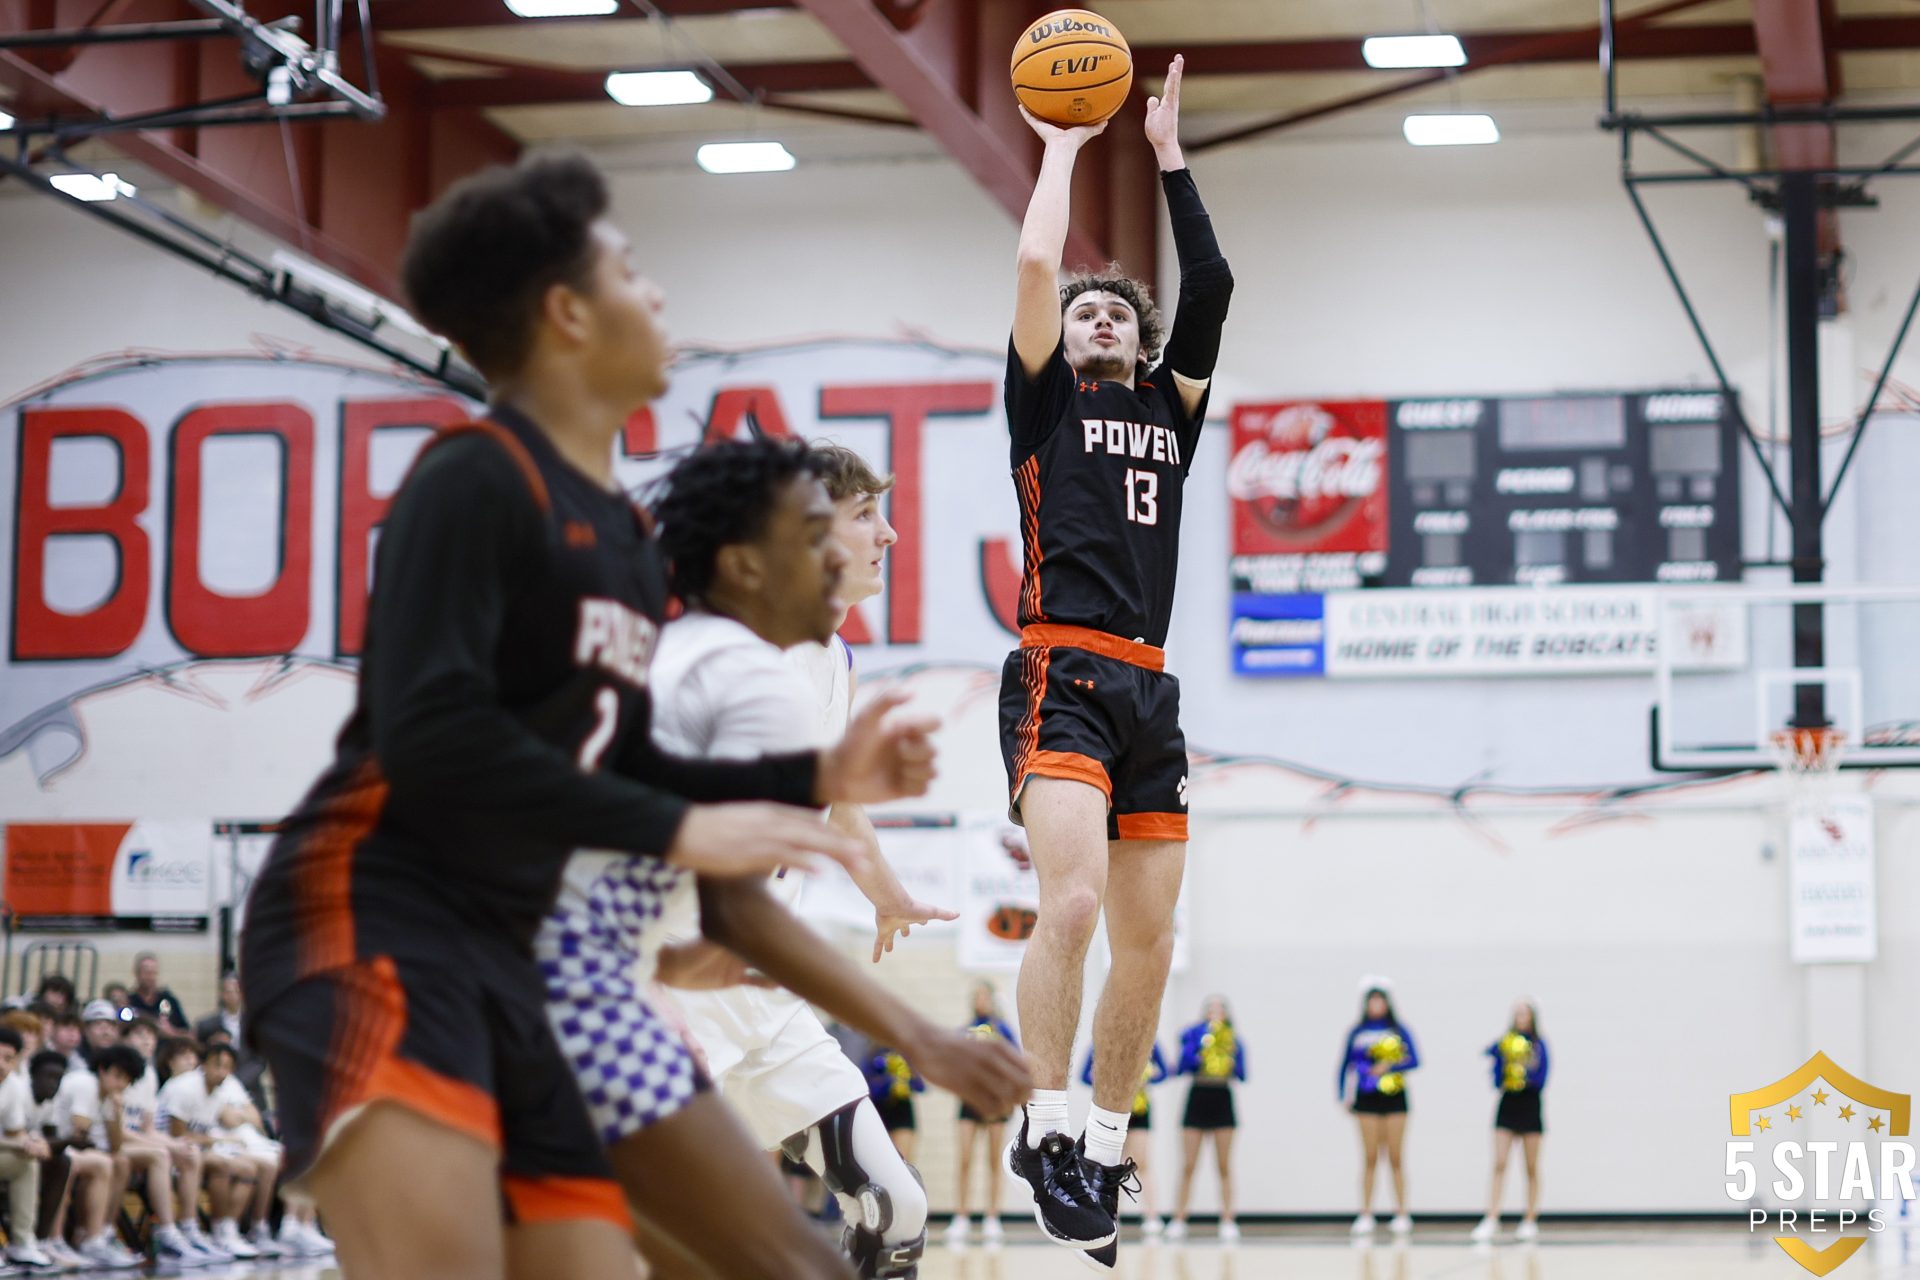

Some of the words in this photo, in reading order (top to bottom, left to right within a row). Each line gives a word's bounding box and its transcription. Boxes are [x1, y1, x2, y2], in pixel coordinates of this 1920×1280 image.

[1030, 18, 1112, 43] Wilson
[1051, 56, 1098, 76] EVO
[1124, 467, 1158, 525] 13
[1337, 635, 1419, 660] HOME
[1427, 634, 1462, 657] OF
[1474, 632, 1521, 656] THE
